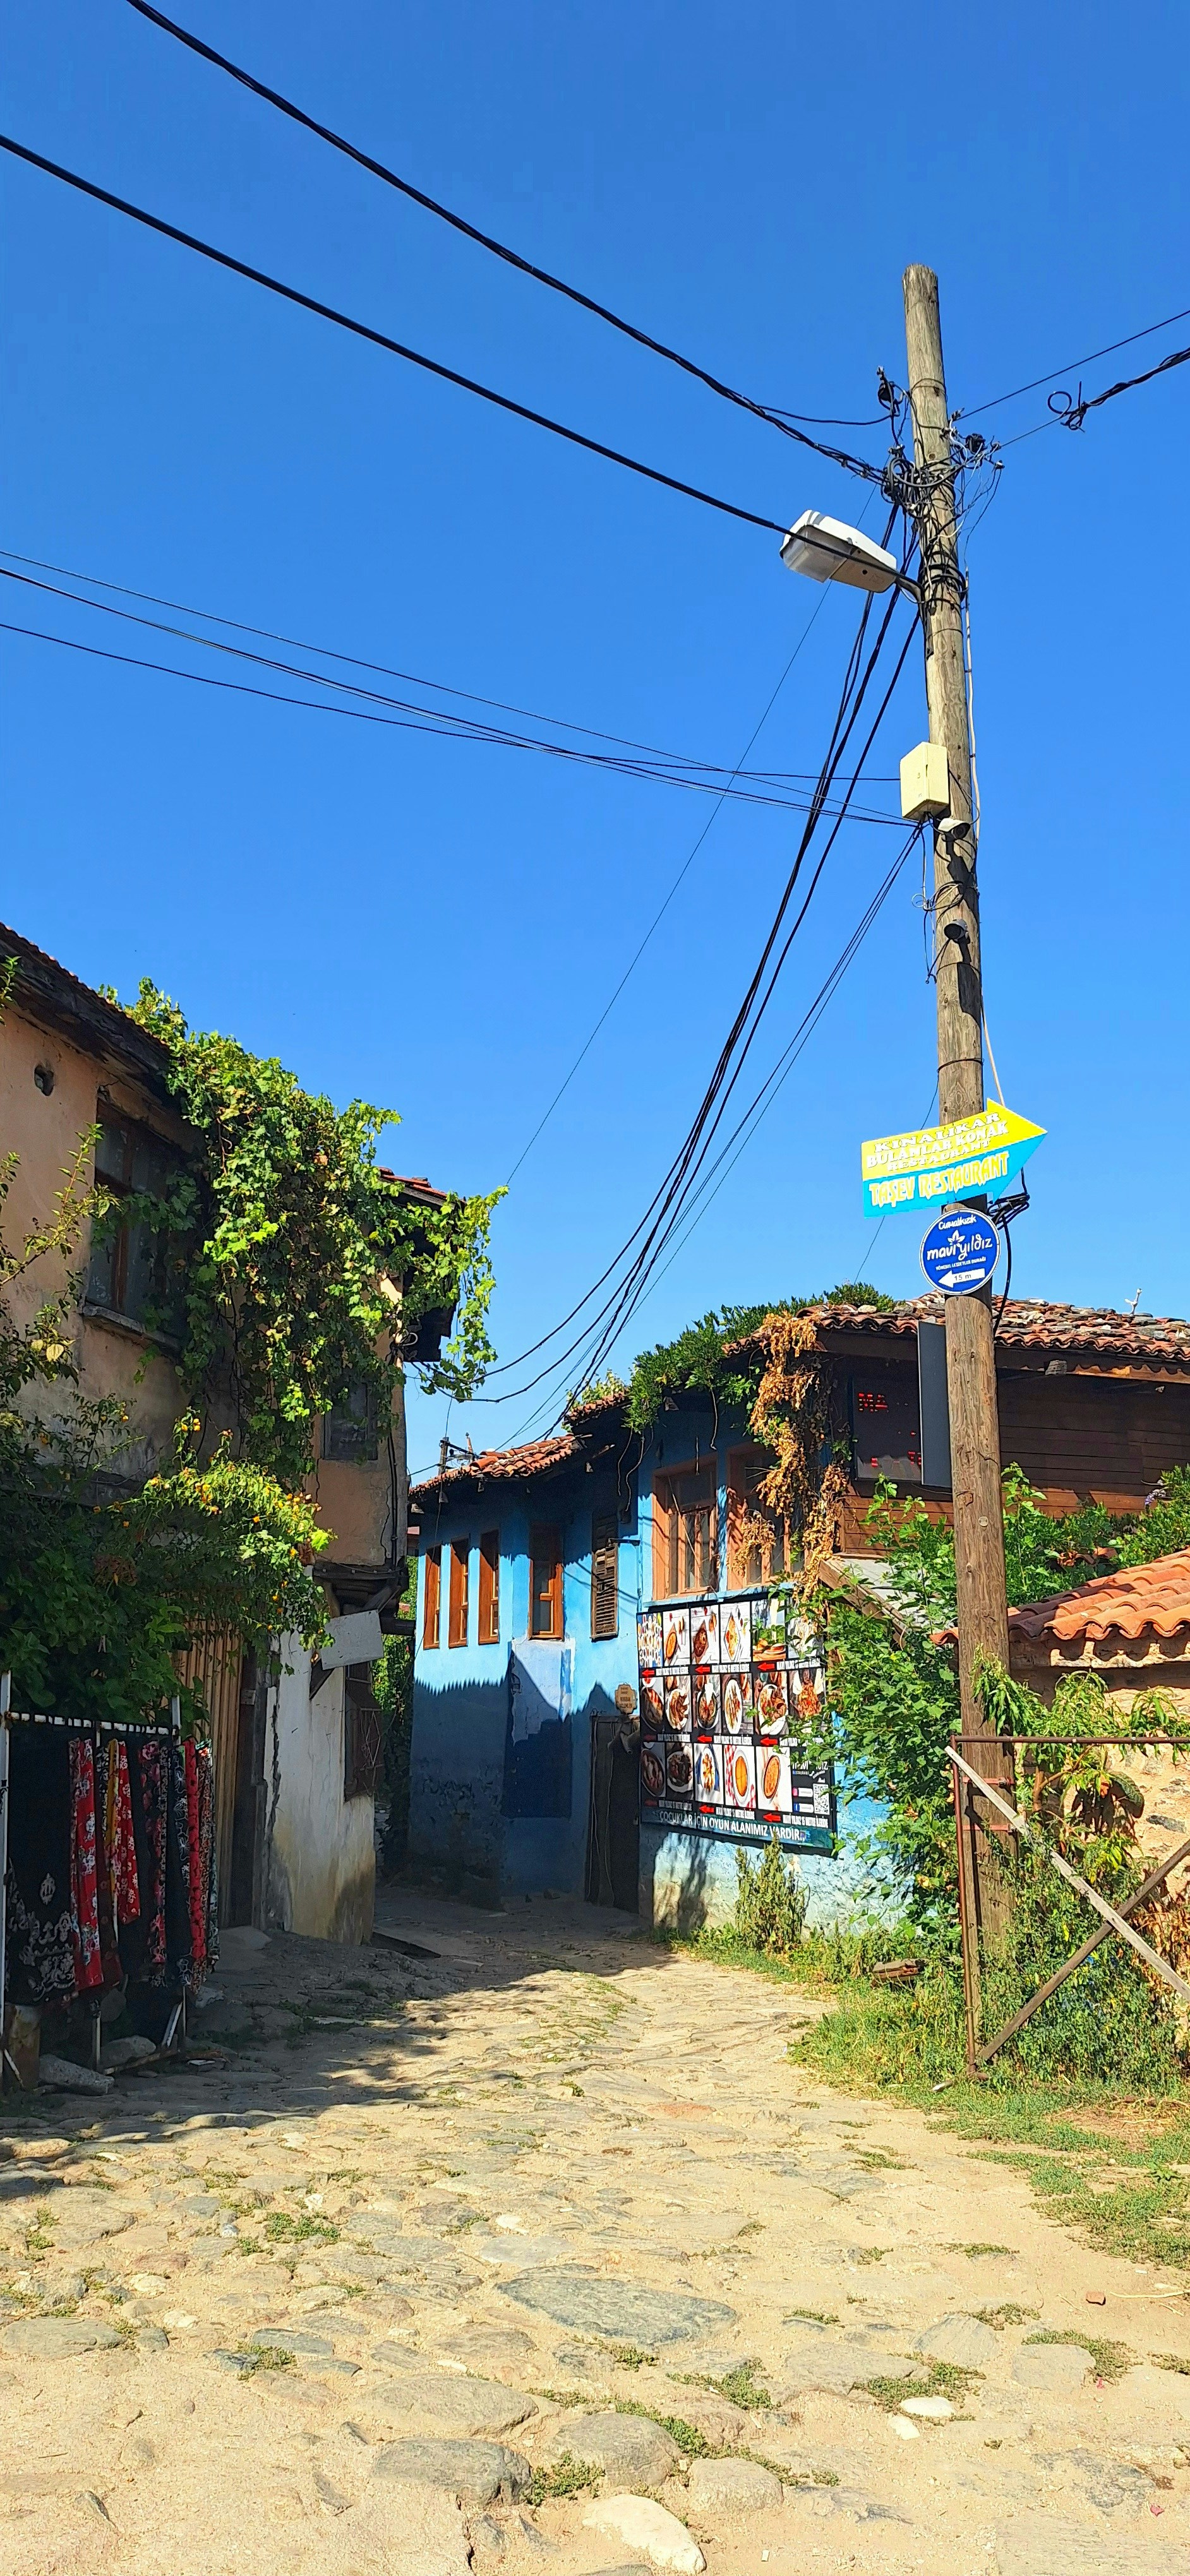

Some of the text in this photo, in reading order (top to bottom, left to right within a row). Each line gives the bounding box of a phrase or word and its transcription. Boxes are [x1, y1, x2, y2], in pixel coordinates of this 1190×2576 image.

[955, 1121, 1010, 1147] KONAK
[887, 1139, 992, 1171] RESTAURANT
[868, 1150, 1010, 1208] TAŞEV RESTAURANT
[659, 1811, 693, 1826] ÇOCUKLAR
[694, 1813, 708, 1829] İÇİN
[709, 1817, 730, 1831] OYUN
[731, 1822, 769, 1837] ALANIMIZ
